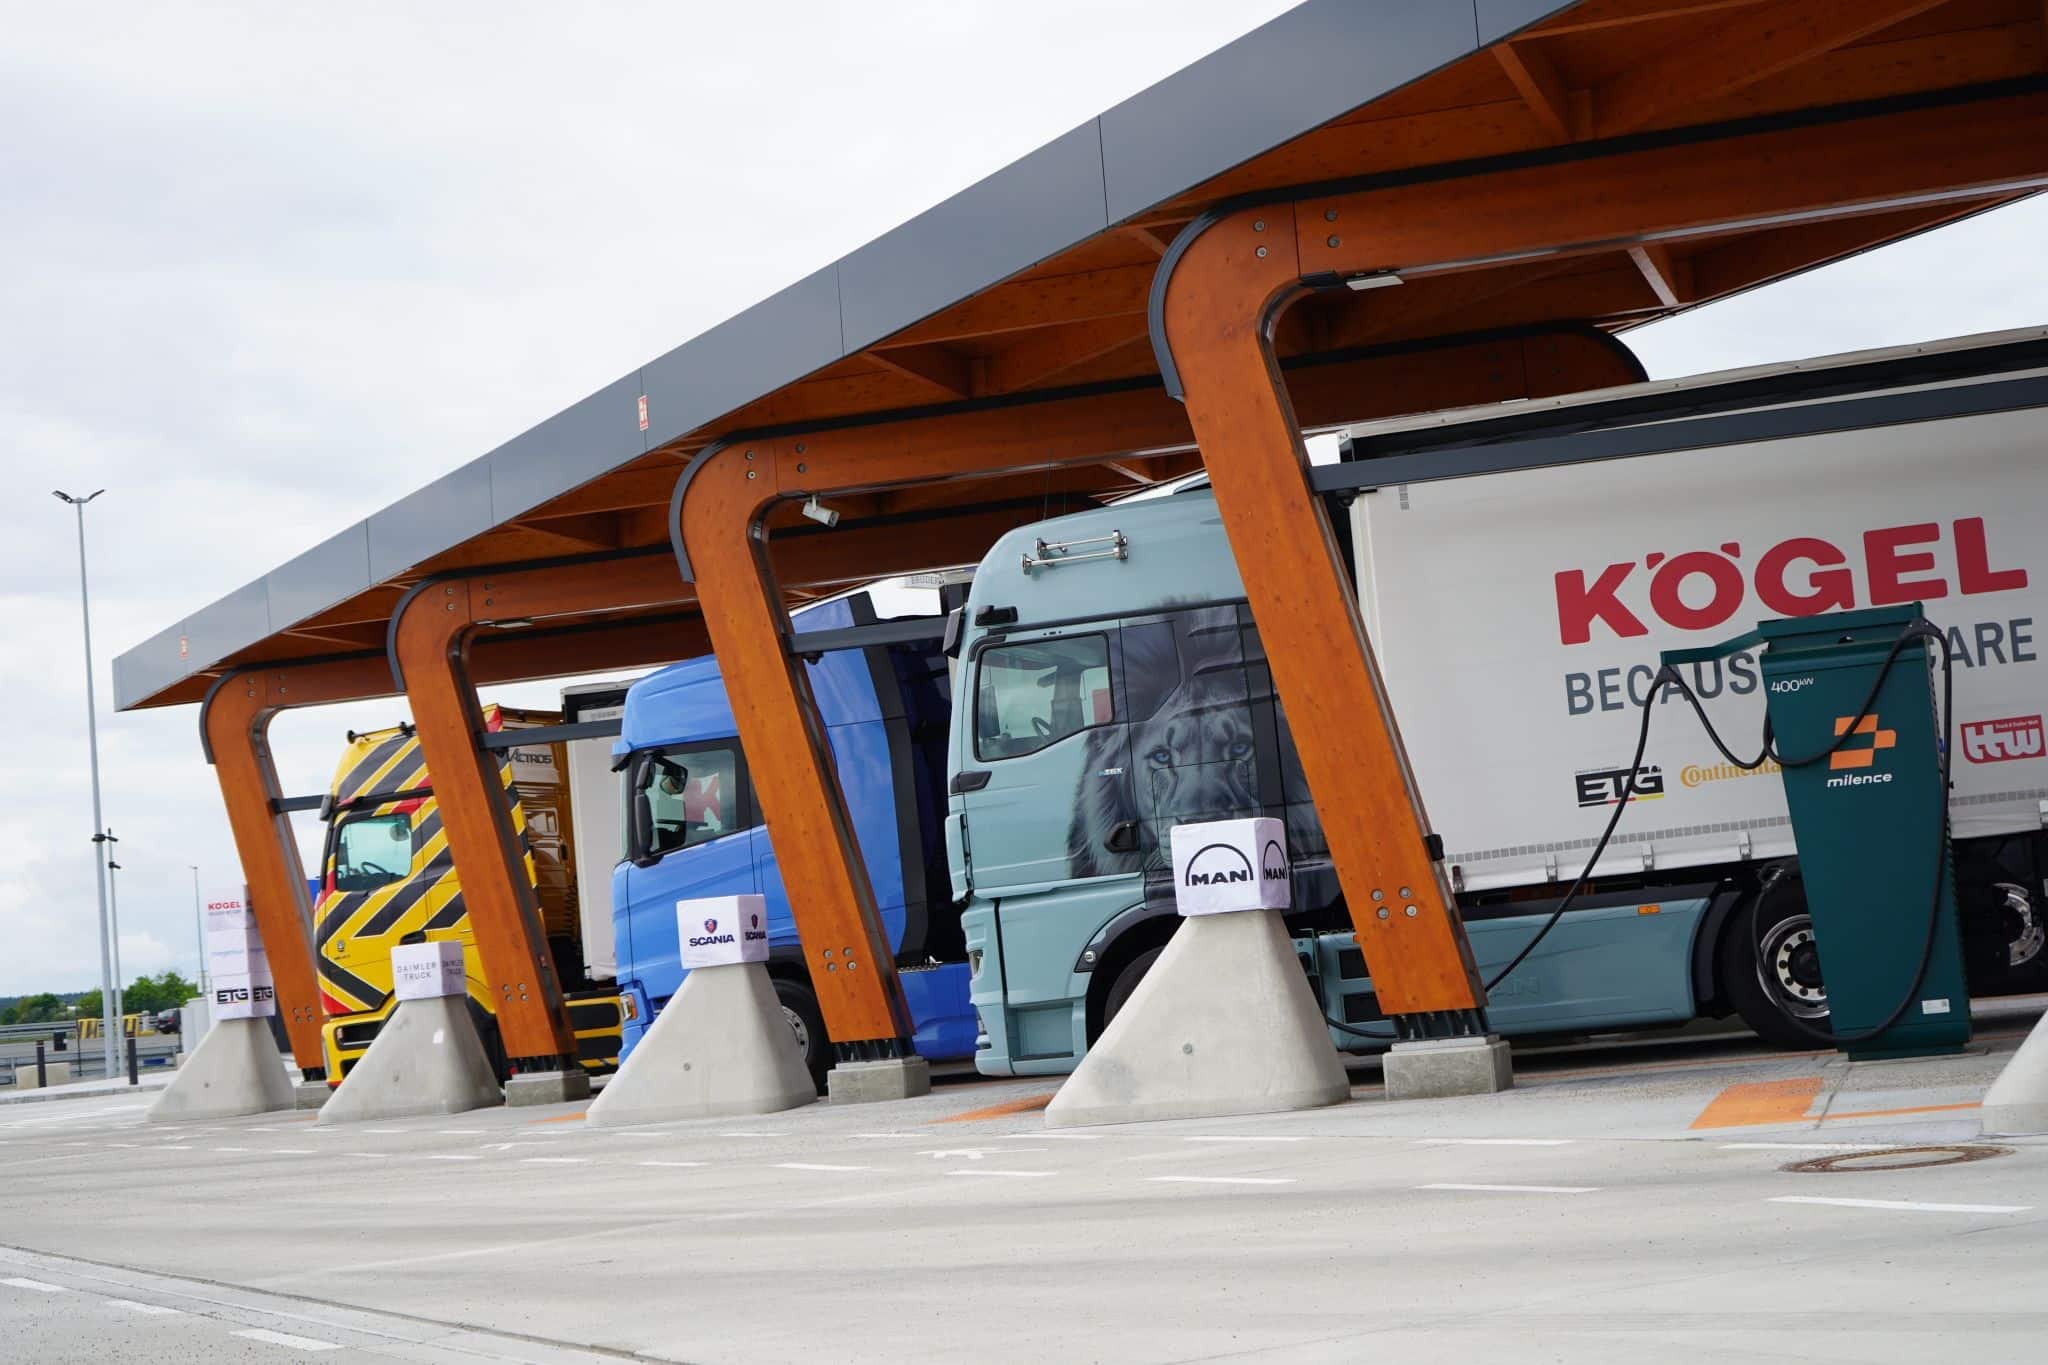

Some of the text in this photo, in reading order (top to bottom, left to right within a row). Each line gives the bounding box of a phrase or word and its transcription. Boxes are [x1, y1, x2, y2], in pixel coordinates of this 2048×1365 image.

[1555, 517, 2028, 645] KÖGEL
[1566, 652, 1758, 715] BECAUS
[1771, 677, 1814, 693] 400kW
[1680, 758, 1782, 788] Continenta
[1827, 773, 1893, 788] milence
[1191, 870, 1247, 886] MAN
[1265, 867, 1285, 880] MAN
[689, 934, 735, 946] SCANIA
[397, 962, 436, 973] DAIMLER
[217, 989, 248, 1002] ETG
